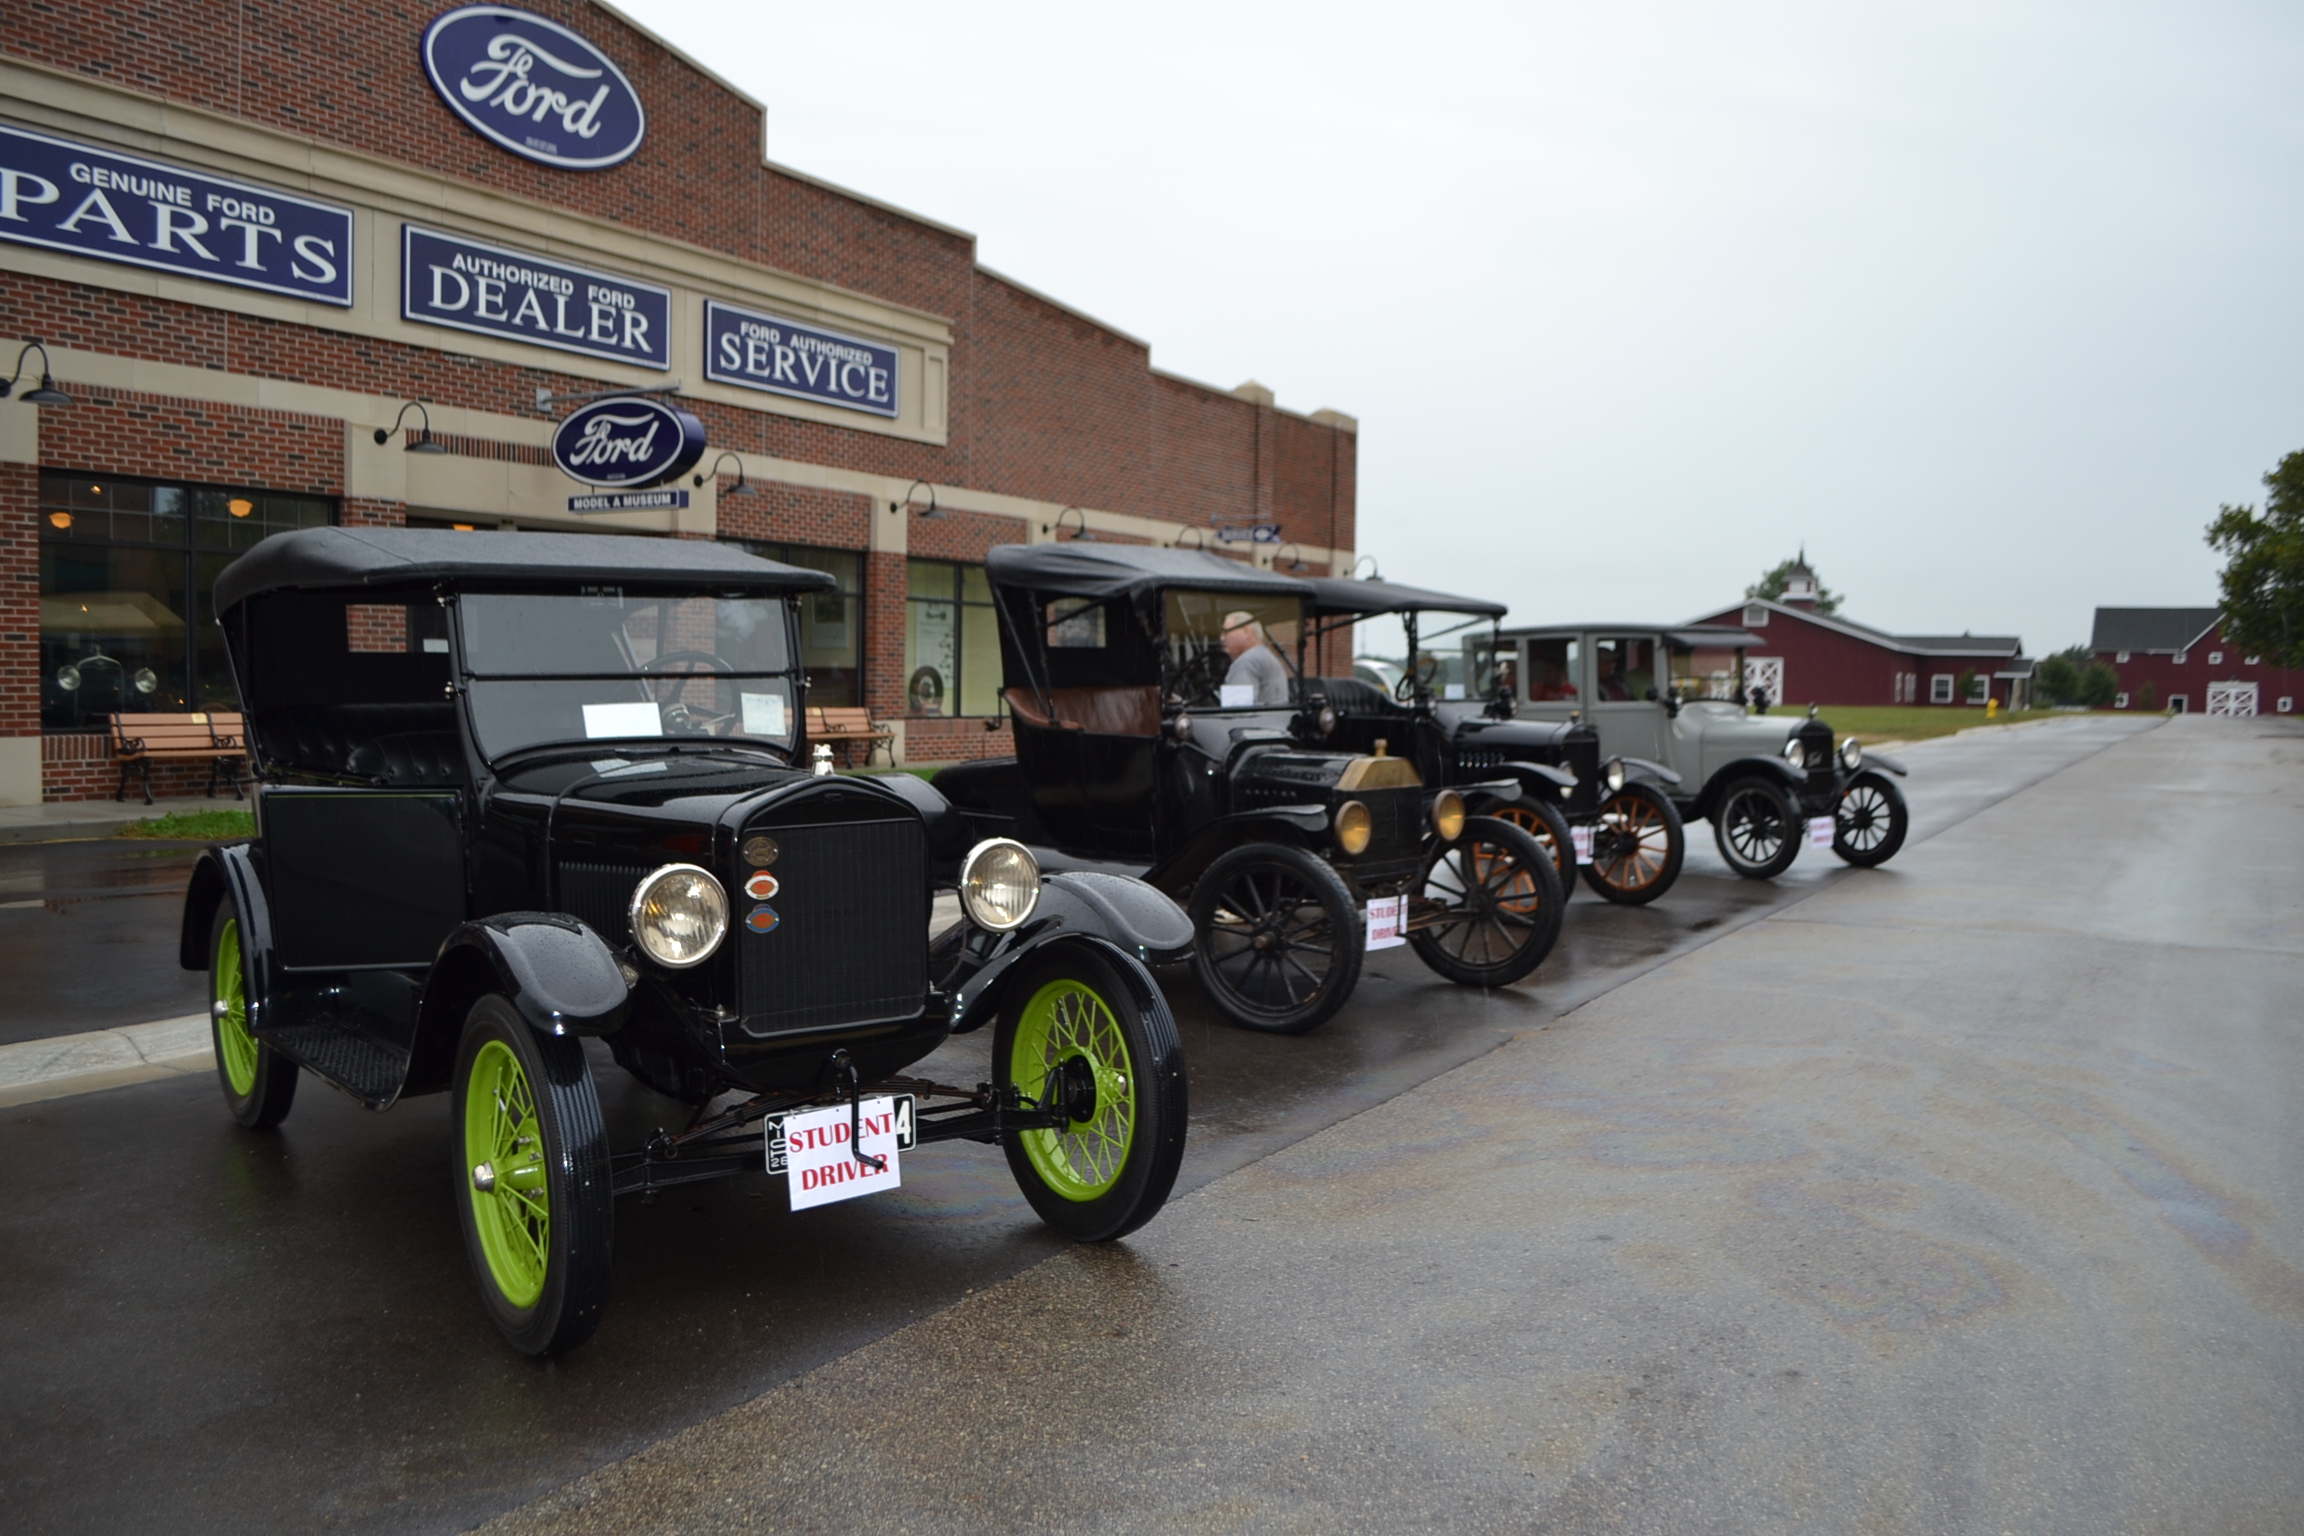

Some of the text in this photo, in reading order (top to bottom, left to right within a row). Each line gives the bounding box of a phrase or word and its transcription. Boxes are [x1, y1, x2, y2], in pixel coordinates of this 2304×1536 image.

[460, 34, 610, 139] Ford
[69, 162, 275, 225] GENUINE FORD
[0, 167, 337, 284] PARTS
[428, 264, 653, 353] DEALER
[452, 253, 635, 310] AUTHORIZED FORD
[719, 332, 889, 404] SERVICE
[740, 321, 873, 366] FORD AUTHORIZED
[569, 412, 660, 466] Ford
[573, 493, 671, 509] MODEL A MUSEUM
[789, 1112, 893, 1153] STUDENT
[802, 1153, 889, 1191] DRIVER
